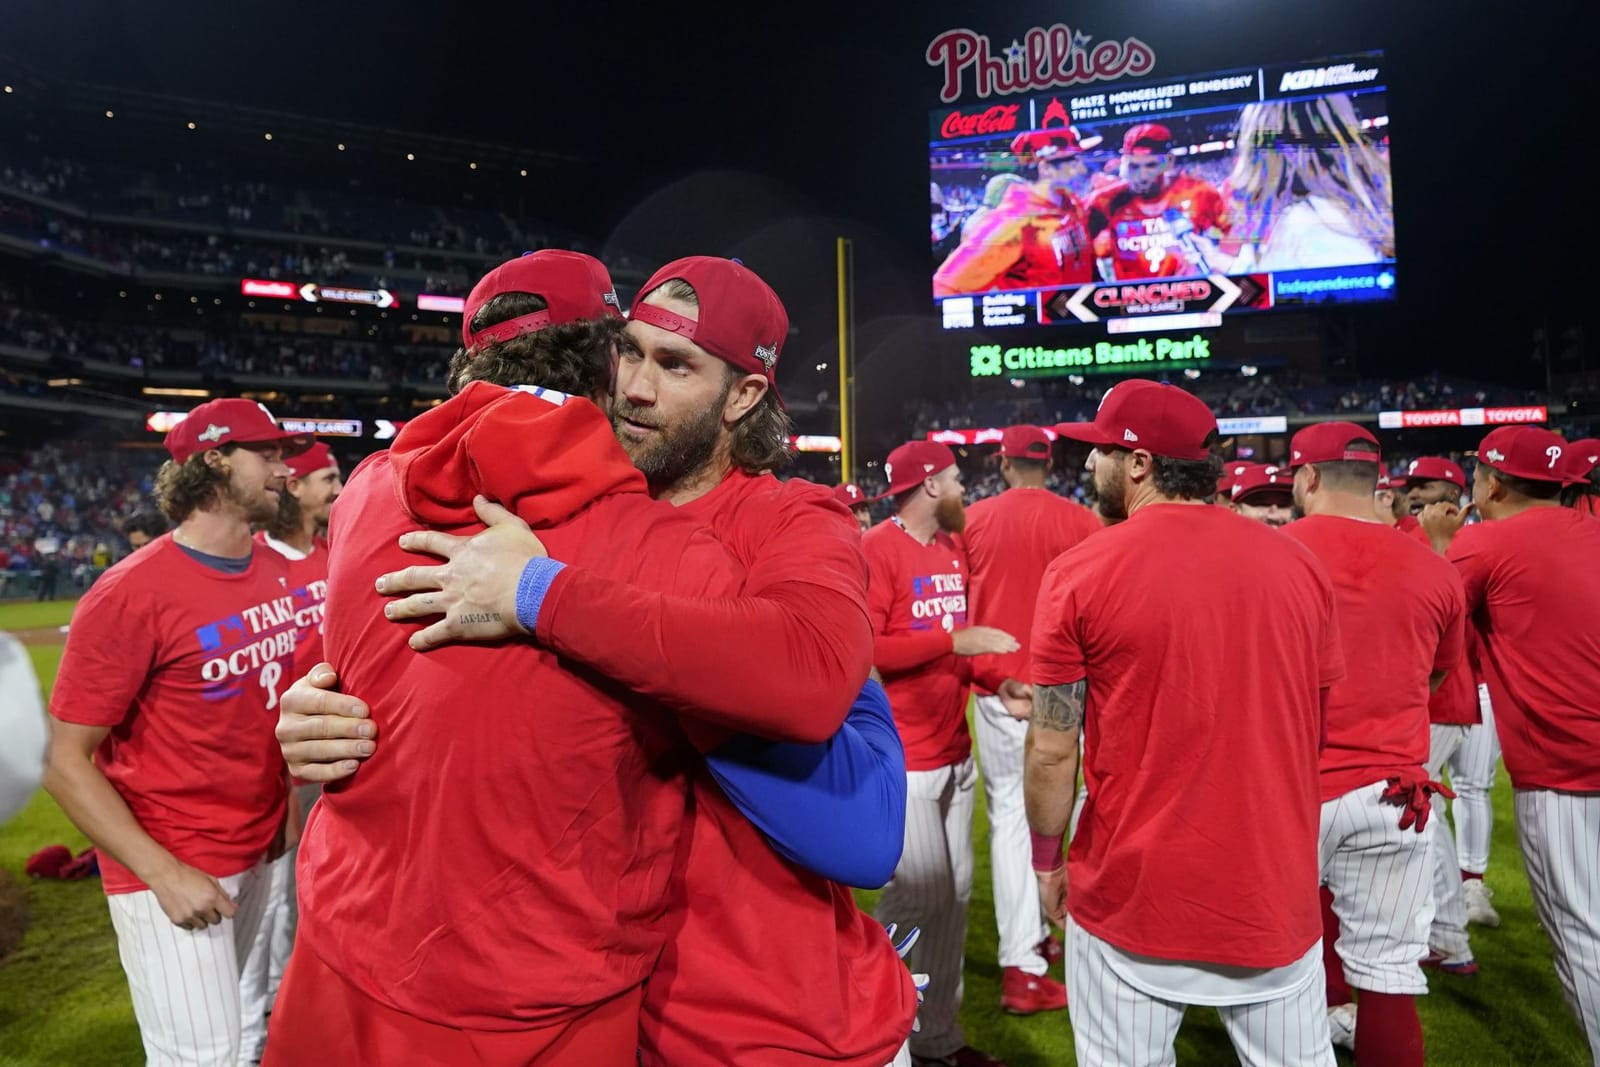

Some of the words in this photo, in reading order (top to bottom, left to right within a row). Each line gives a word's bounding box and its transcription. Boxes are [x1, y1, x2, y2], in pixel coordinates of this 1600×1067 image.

[926, 23, 1155, 102] Phillies
[1189, 75, 1253, 95] BENDESKY
[1072, 106, 1107, 120] TRIAL
[1115, 98, 1173, 115] LAWYERS
[320, 289, 345, 299] WILD
[1093, 280, 1211, 308] CLINCHED
[1277, 276, 1375, 295] Independence
[1004, 345, 1093, 370] Citizens
[1095, 338, 1155, 364] Bank
[1156, 334, 1211, 361] Park
[282, 421, 316, 433] WILD
[1404, 411, 1459, 426] TOYOTA
[1486, 408, 1543, 422] TOYOTA
[1545, 445, 1562, 469] P
[202, 627, 298, 682] OCTOBE
[259, 661, 282, 710] P
